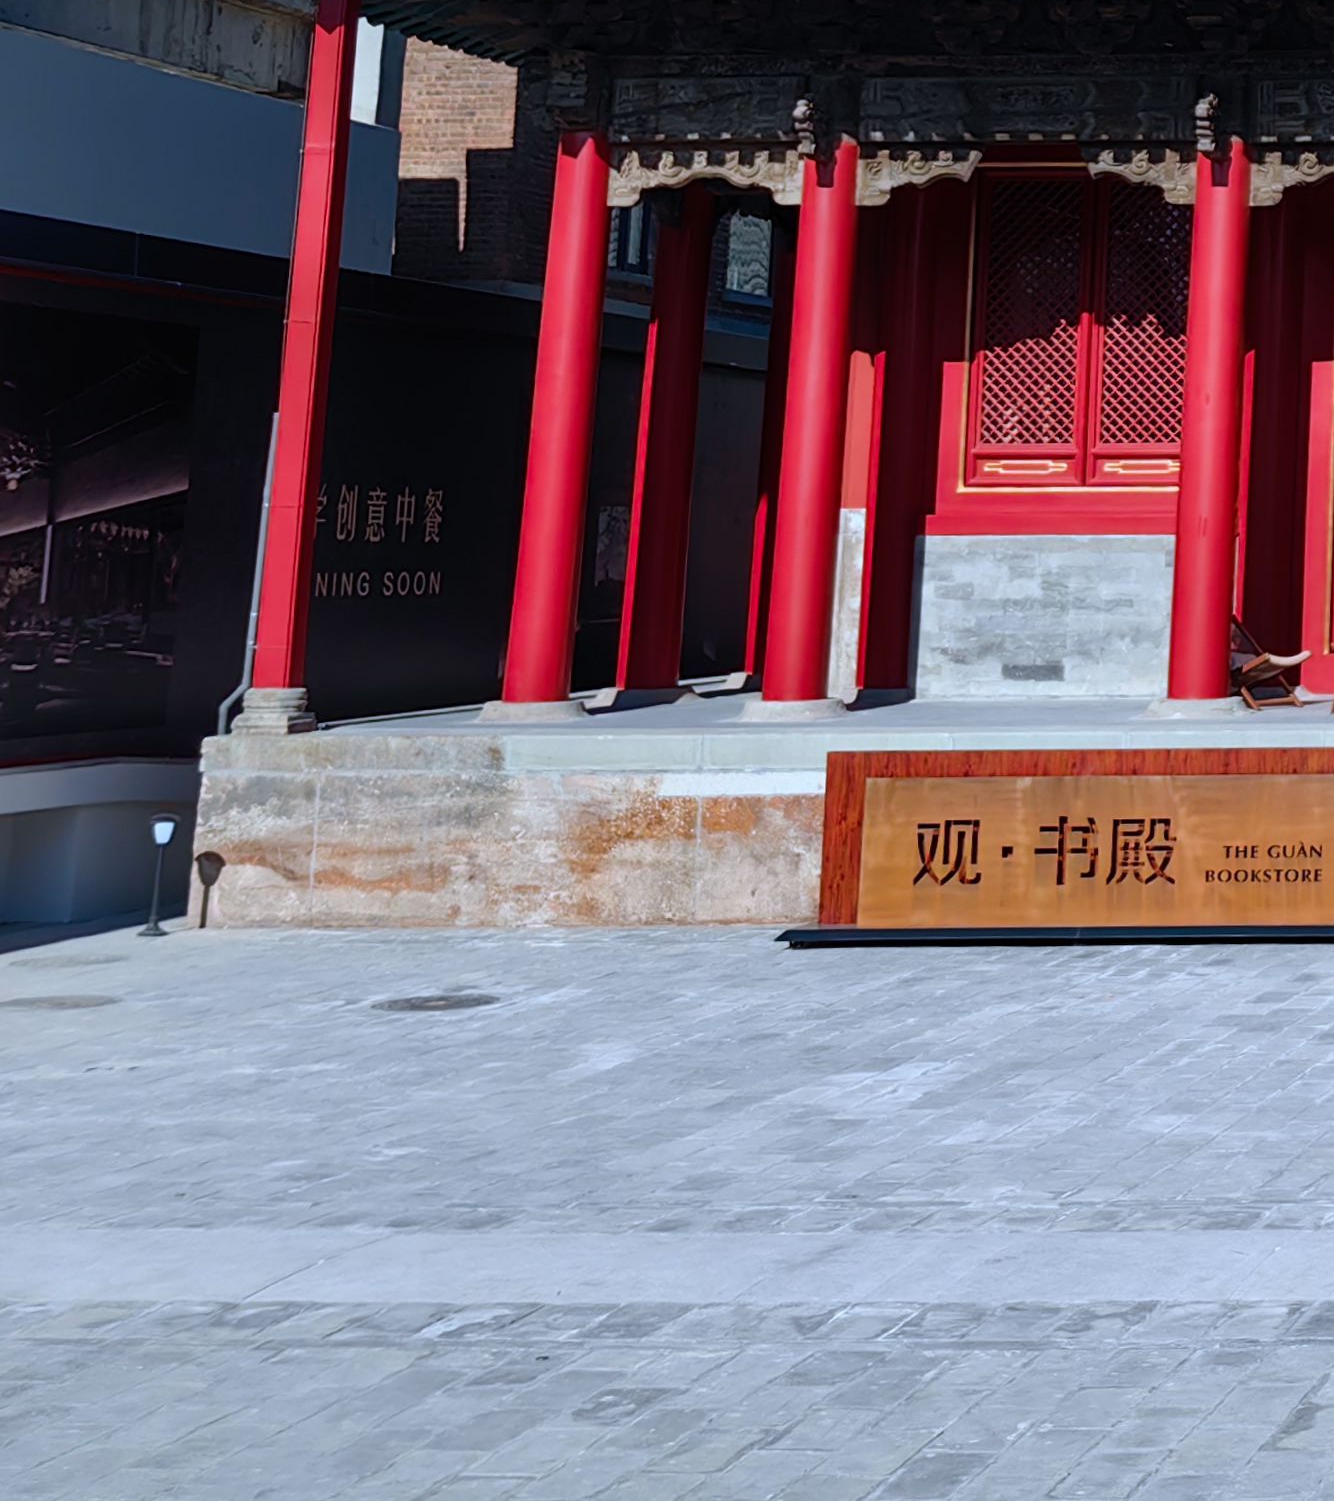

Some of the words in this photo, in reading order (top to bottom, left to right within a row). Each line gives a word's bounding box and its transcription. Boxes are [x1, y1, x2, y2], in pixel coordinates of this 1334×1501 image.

[383, 571, 442, 596] SOON
[1222, 845, 1259, 859] THE
[1205, 868, 1323, 883] BOOKSTORE
